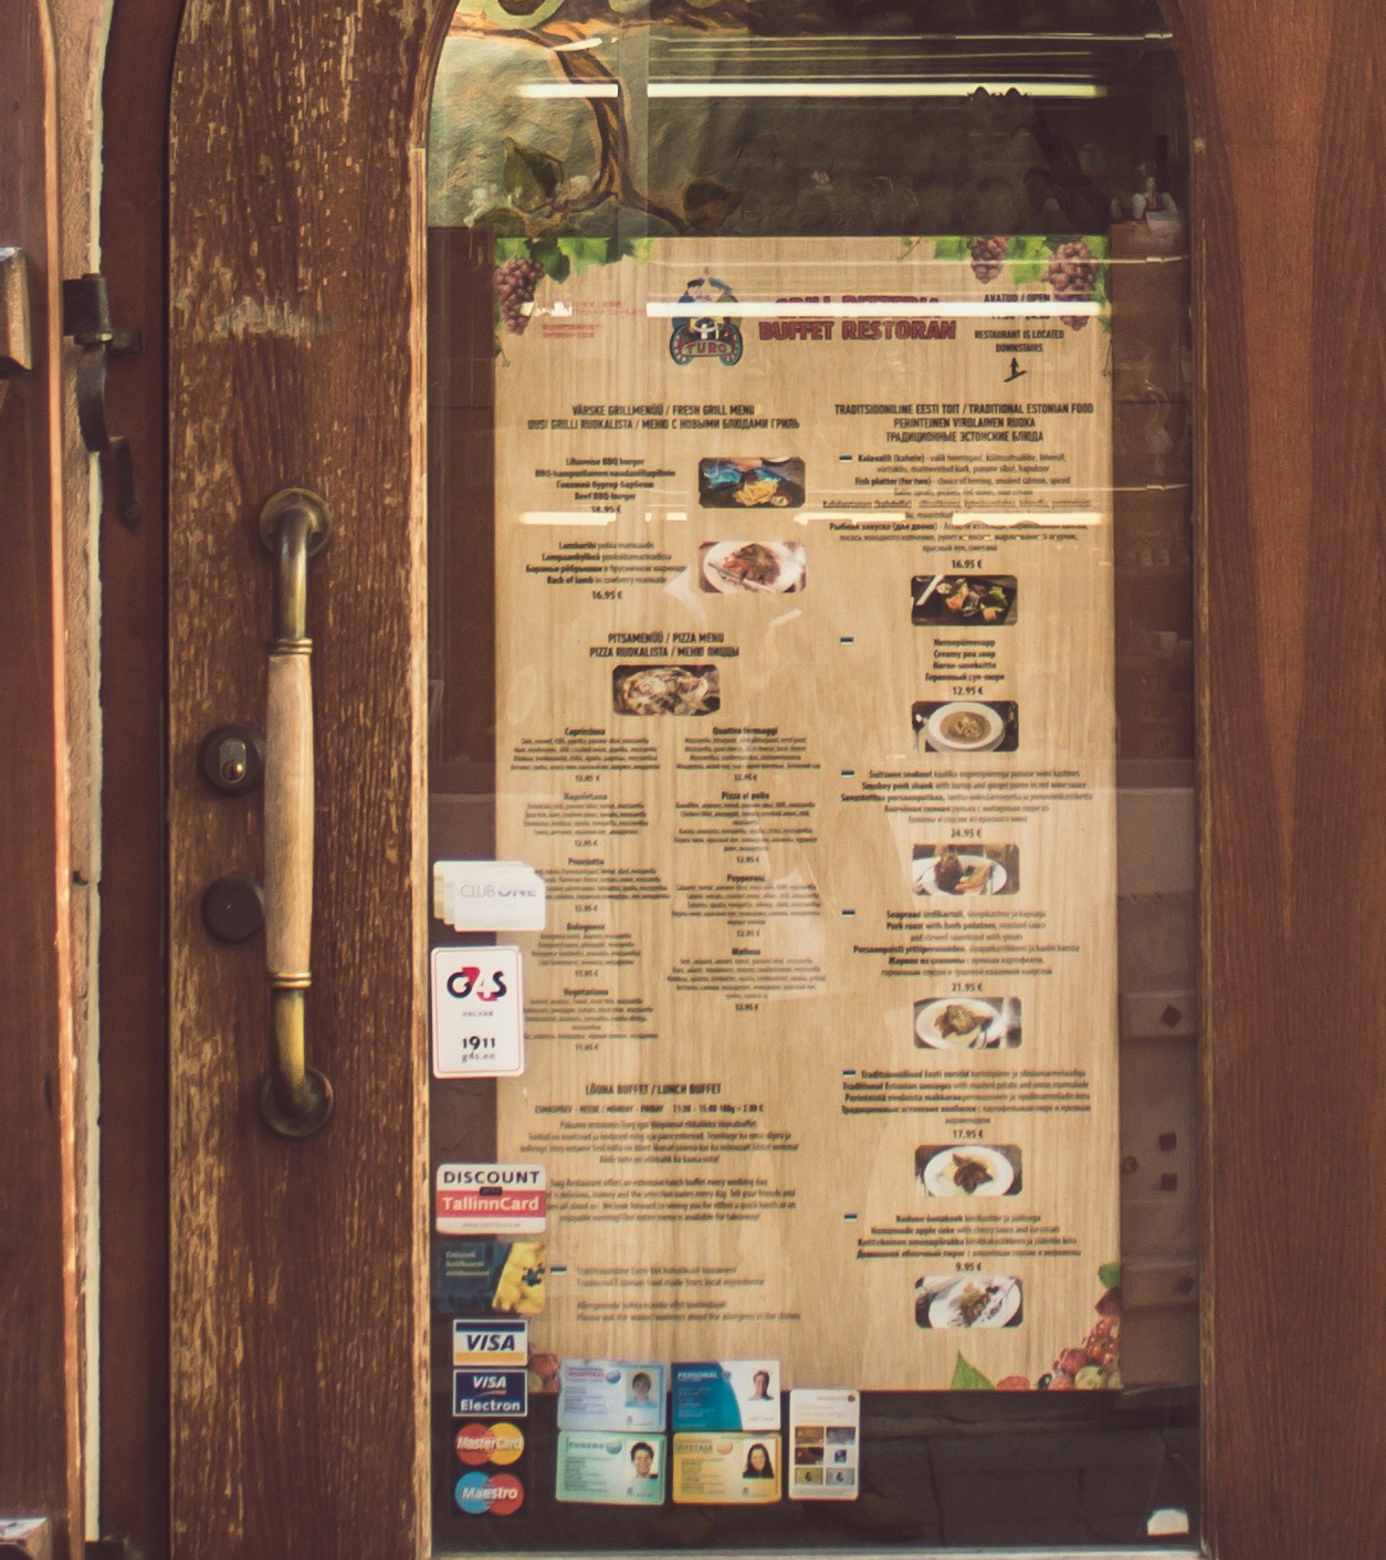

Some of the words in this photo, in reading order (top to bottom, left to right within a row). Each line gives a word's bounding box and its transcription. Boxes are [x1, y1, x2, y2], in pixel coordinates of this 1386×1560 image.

[759, 321, 834, 340] BUFFET
[842, 320, 957, 340] RESTORAN
[974, 330, 1021, 339] RESTAURANT
[1023, 330, 1031, 339] IS
[1032, 330, 1064, 339] LOCATED
[685, 341, 729, 355] TURG
[995, 343, 1043, 353] DOWNSTAIRS
[572, 405, 604, 416] VÄRSKE
[672, 404, 700, 416] FRESH
[703, 404, 727, 416] GRILL
[730, 404, 754, 416] MENU
[916, 403, 939, 415] EESTI
[942, 403, 959, 415] TOIT
[969, 403, 1023, 414] TRADITIONAL
[1026, 403, 1069, 414] ESTONIAN
[1071, 403, 1093, 414] FOOD
[854, 477, 870, 485] Fish
[564, 576, 574, 584] of
[592, 590, 616, 600] 16.95
[672, 632, 696, 644] PIZZA
[698, 632, 724, 643] MENU
[589, 646, 613, 658] PIZZA
[953, 685, 976, 696] 12.95
[721, 791, 741, 800] Pizza
[460, 884, 495, 898] CLUB
[446, 966, 507, 1002] G4S
[462, 1036, 496, 1050] 1911
[617, 1083, 648, 1095] BUFFET
[658, 1083, 687, 1095] LUNCH
[689, 1083, 721, 1095] BUFFET
[443, 1170, 540, 1185] DISCOUNT
[442, 1196, 540, 1212] TallinnCard
[466, 1333, 516, 1352] VISA
[472, 1375, 507, 1390] VISA
[460, 1399, 521, 1413] Electron
[457, 1435, 523, 1451] MasterCard
[462, 1486, 518, 1500] Maestro
